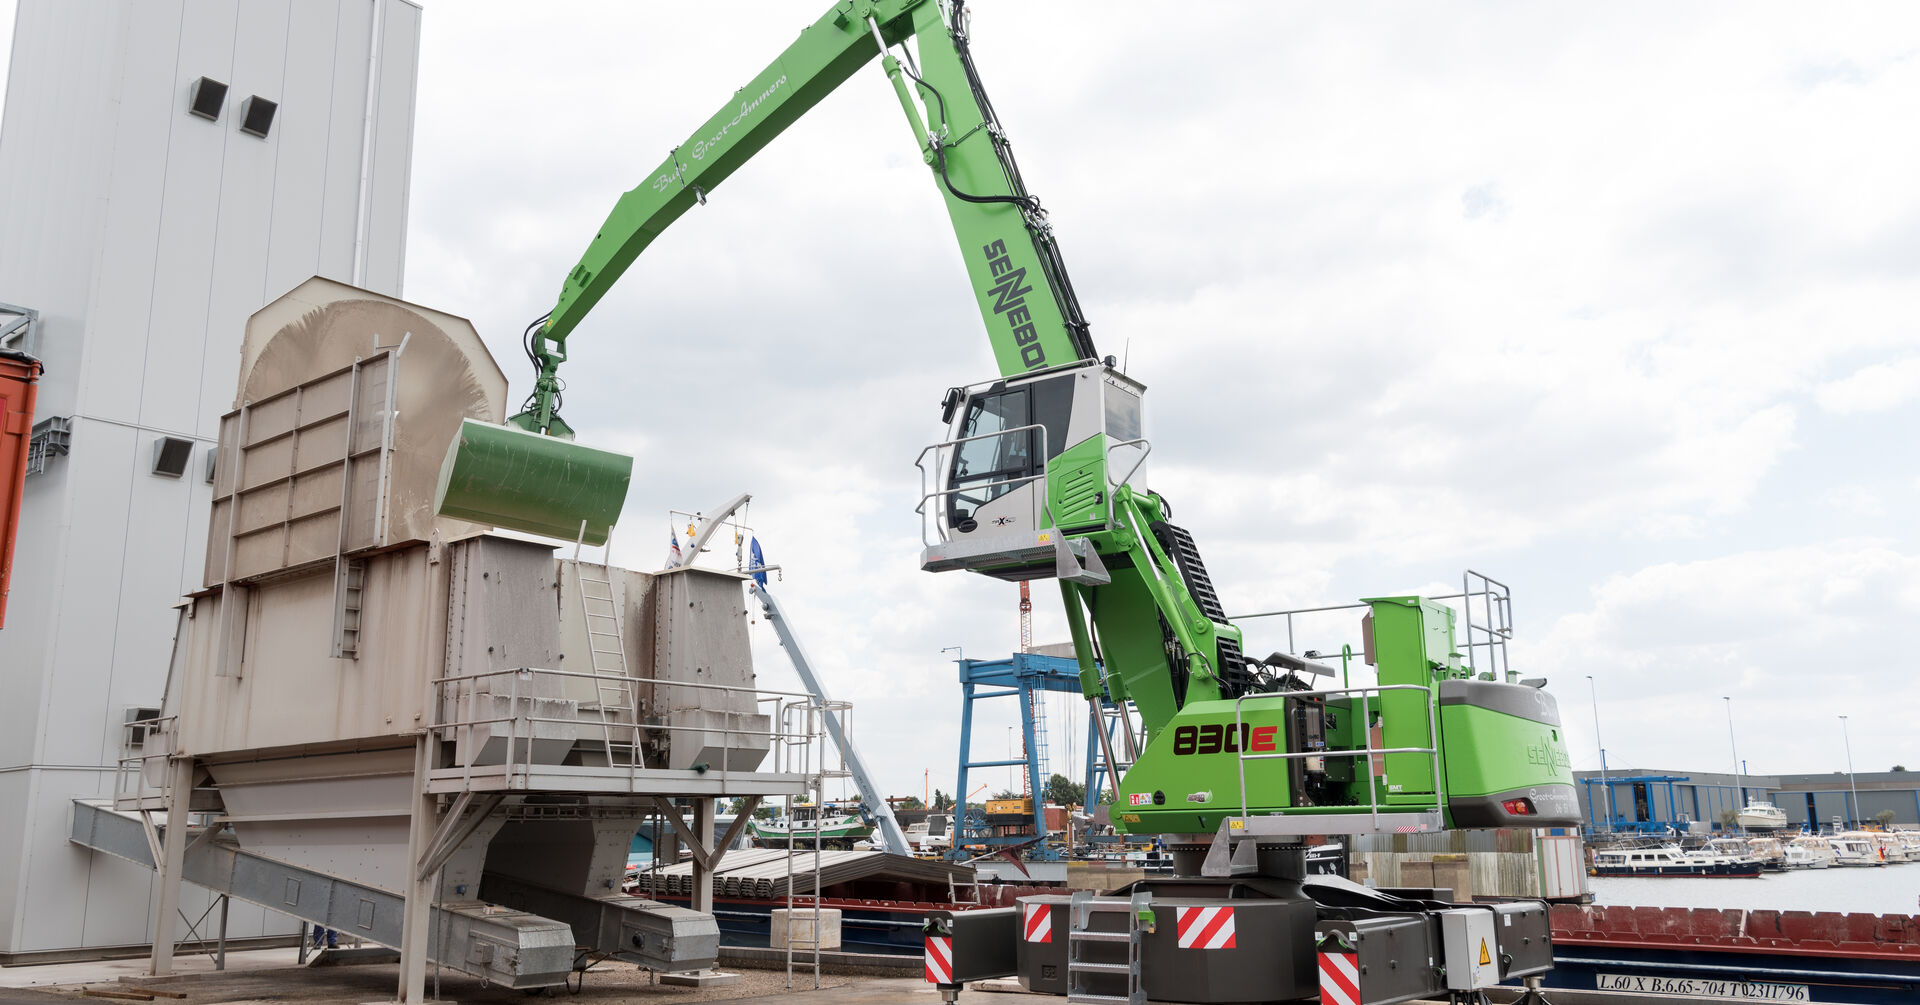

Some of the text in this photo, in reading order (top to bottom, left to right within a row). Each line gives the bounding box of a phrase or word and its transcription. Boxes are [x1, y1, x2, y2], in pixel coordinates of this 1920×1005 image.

[983, 238, 1049, 371] SENNEBO
[1173, 722, 1278, 756] 830E
[1600, 975, 1631, 990] L.60
[1634, 977, 1646, 991] X
